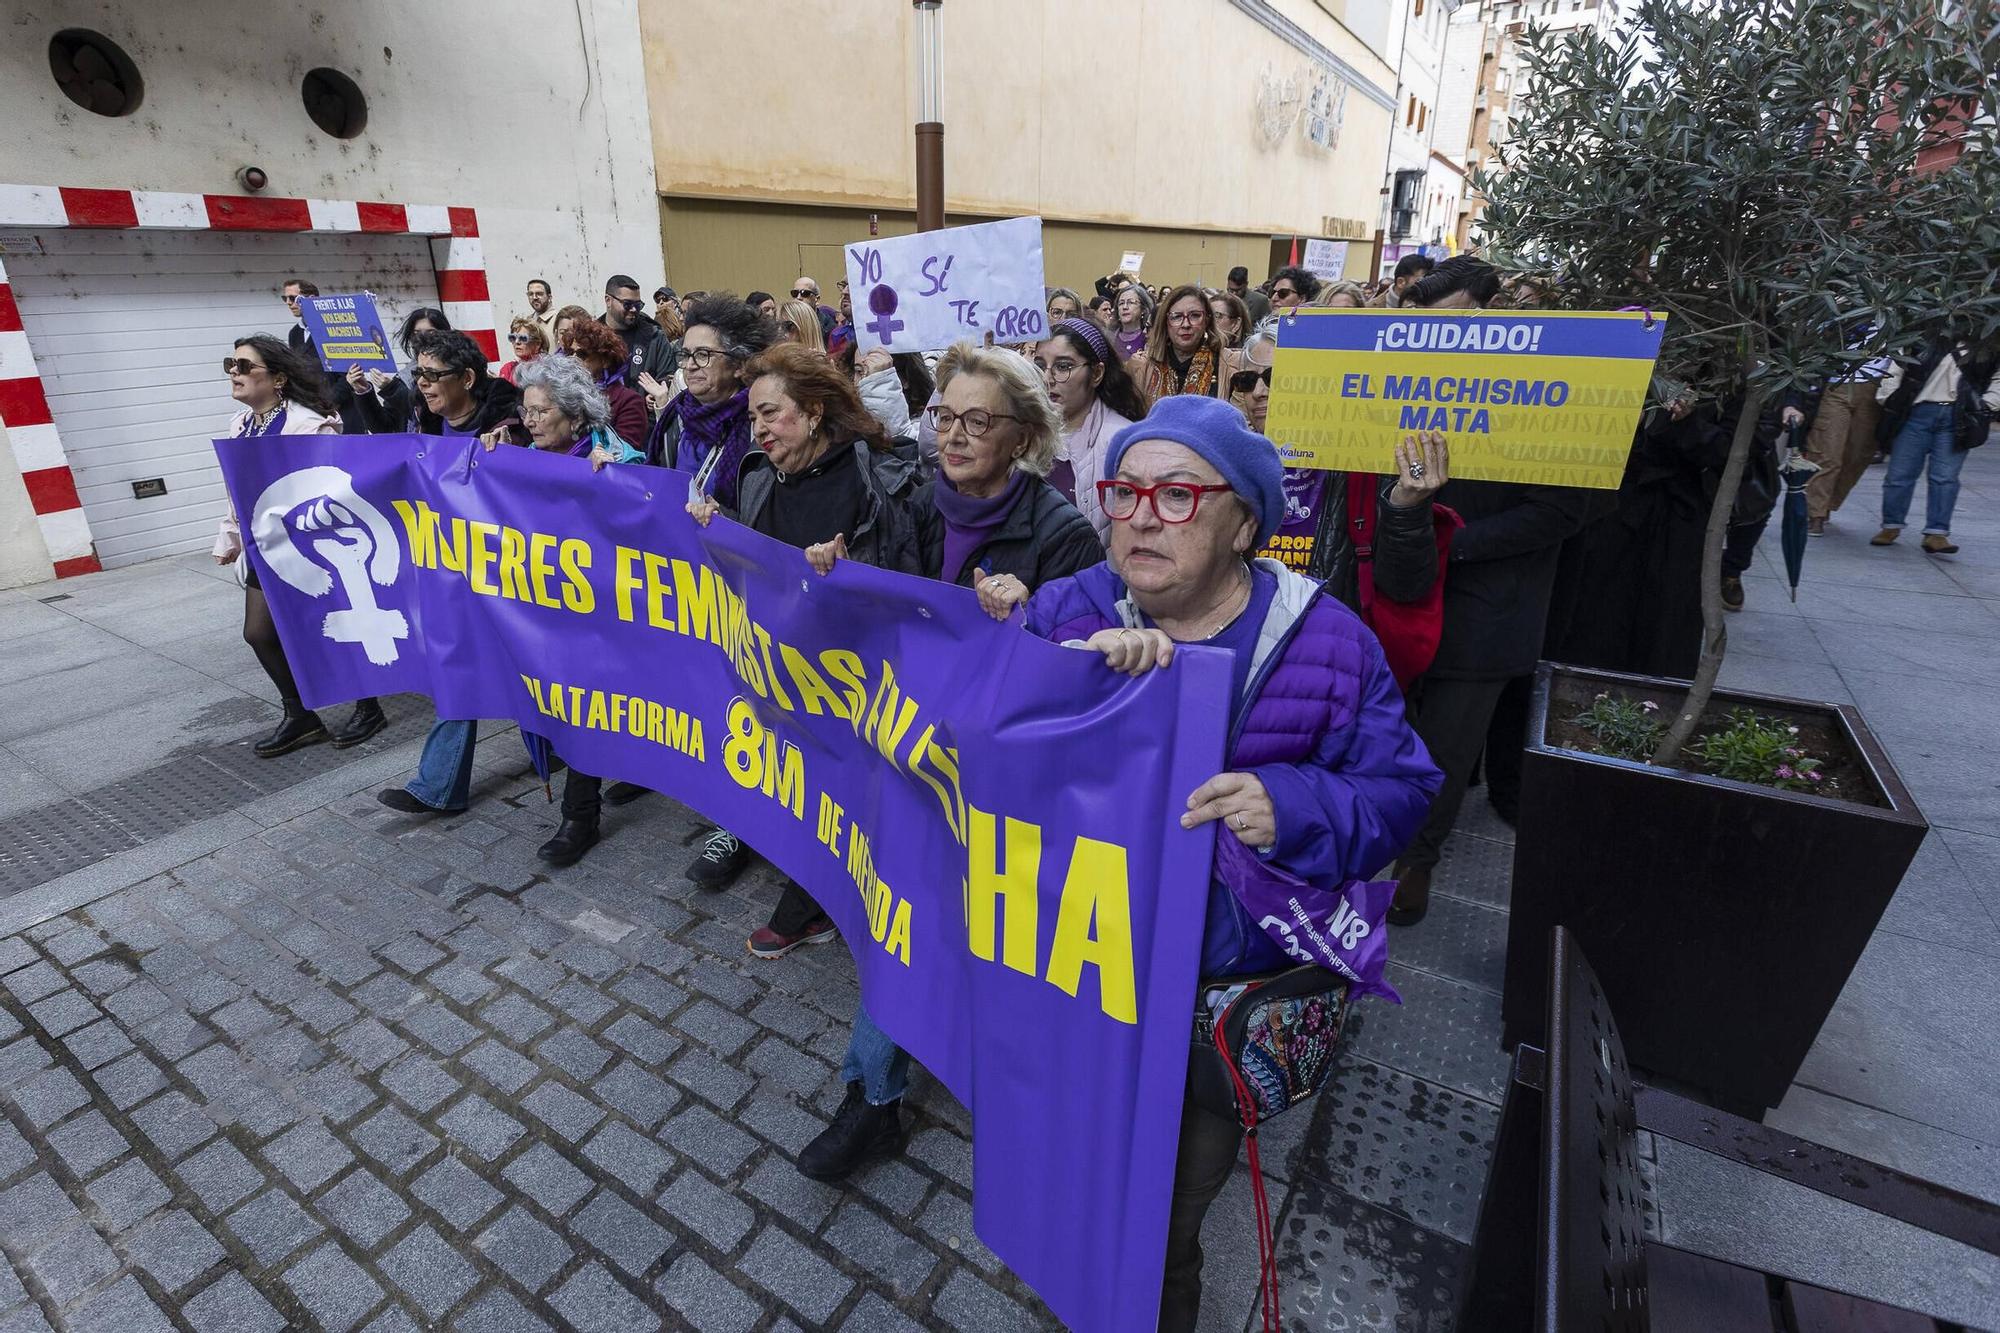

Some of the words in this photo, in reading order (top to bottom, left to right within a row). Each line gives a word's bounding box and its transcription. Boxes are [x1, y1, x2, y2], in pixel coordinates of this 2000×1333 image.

[850, 247, 882, 286] YO
[313, 298, 337, 311] FRENTE
[336, 298, 344, 309] A
[343, 298, 356, 309] LAS
[321, 312, 357, 324] VIOLENCIAS
[949, 300, 979, 327] TE
[995, 305, 1042, 338] CREO
[326, 326, 362, 337] MACHISTAS
[1374, 322, 1543, 353] ¡CUIDADO!
[1341, 373, 1375, 399] EL
[1383, 375, 1569, 408] MACHISMO
[1399, 405, 1489, 433] MATA
[1276, 447, 1315, 459] lvaluna
[1268, 535, 1315, 550] PROF
[616, 545, 867, 737] FEMINISTAS
[721, 695, 805, 822] 8M
[817, 791, 845, 858] DE
